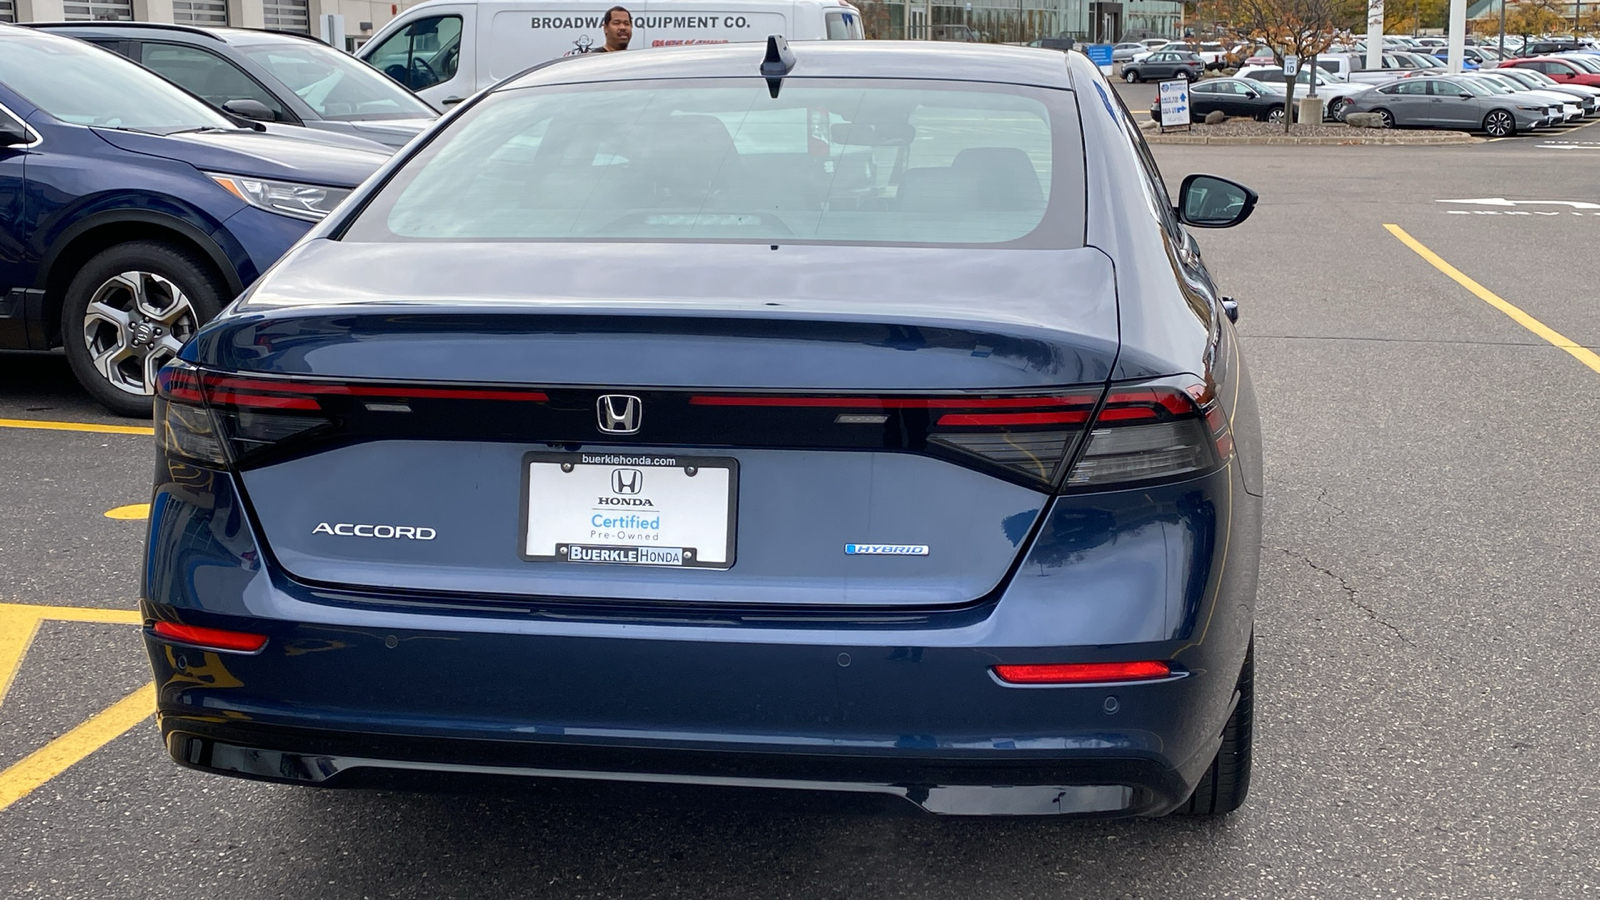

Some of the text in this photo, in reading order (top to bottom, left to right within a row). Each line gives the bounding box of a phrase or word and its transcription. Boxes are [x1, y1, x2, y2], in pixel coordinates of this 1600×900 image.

[724, 16, 751, 29] CO.
[1286, 65, 1295, 73] 10
[582, 454, 676, 467] buerklehonda.com
[597, 497, 654, 507] HONDA
[591, 514, 660, 530] Certified
[312, 522, 437, 540] ACCORD
[590, 530, 659, 541] Pre-Owned
[857, 545, 924, 554] HYBRID
